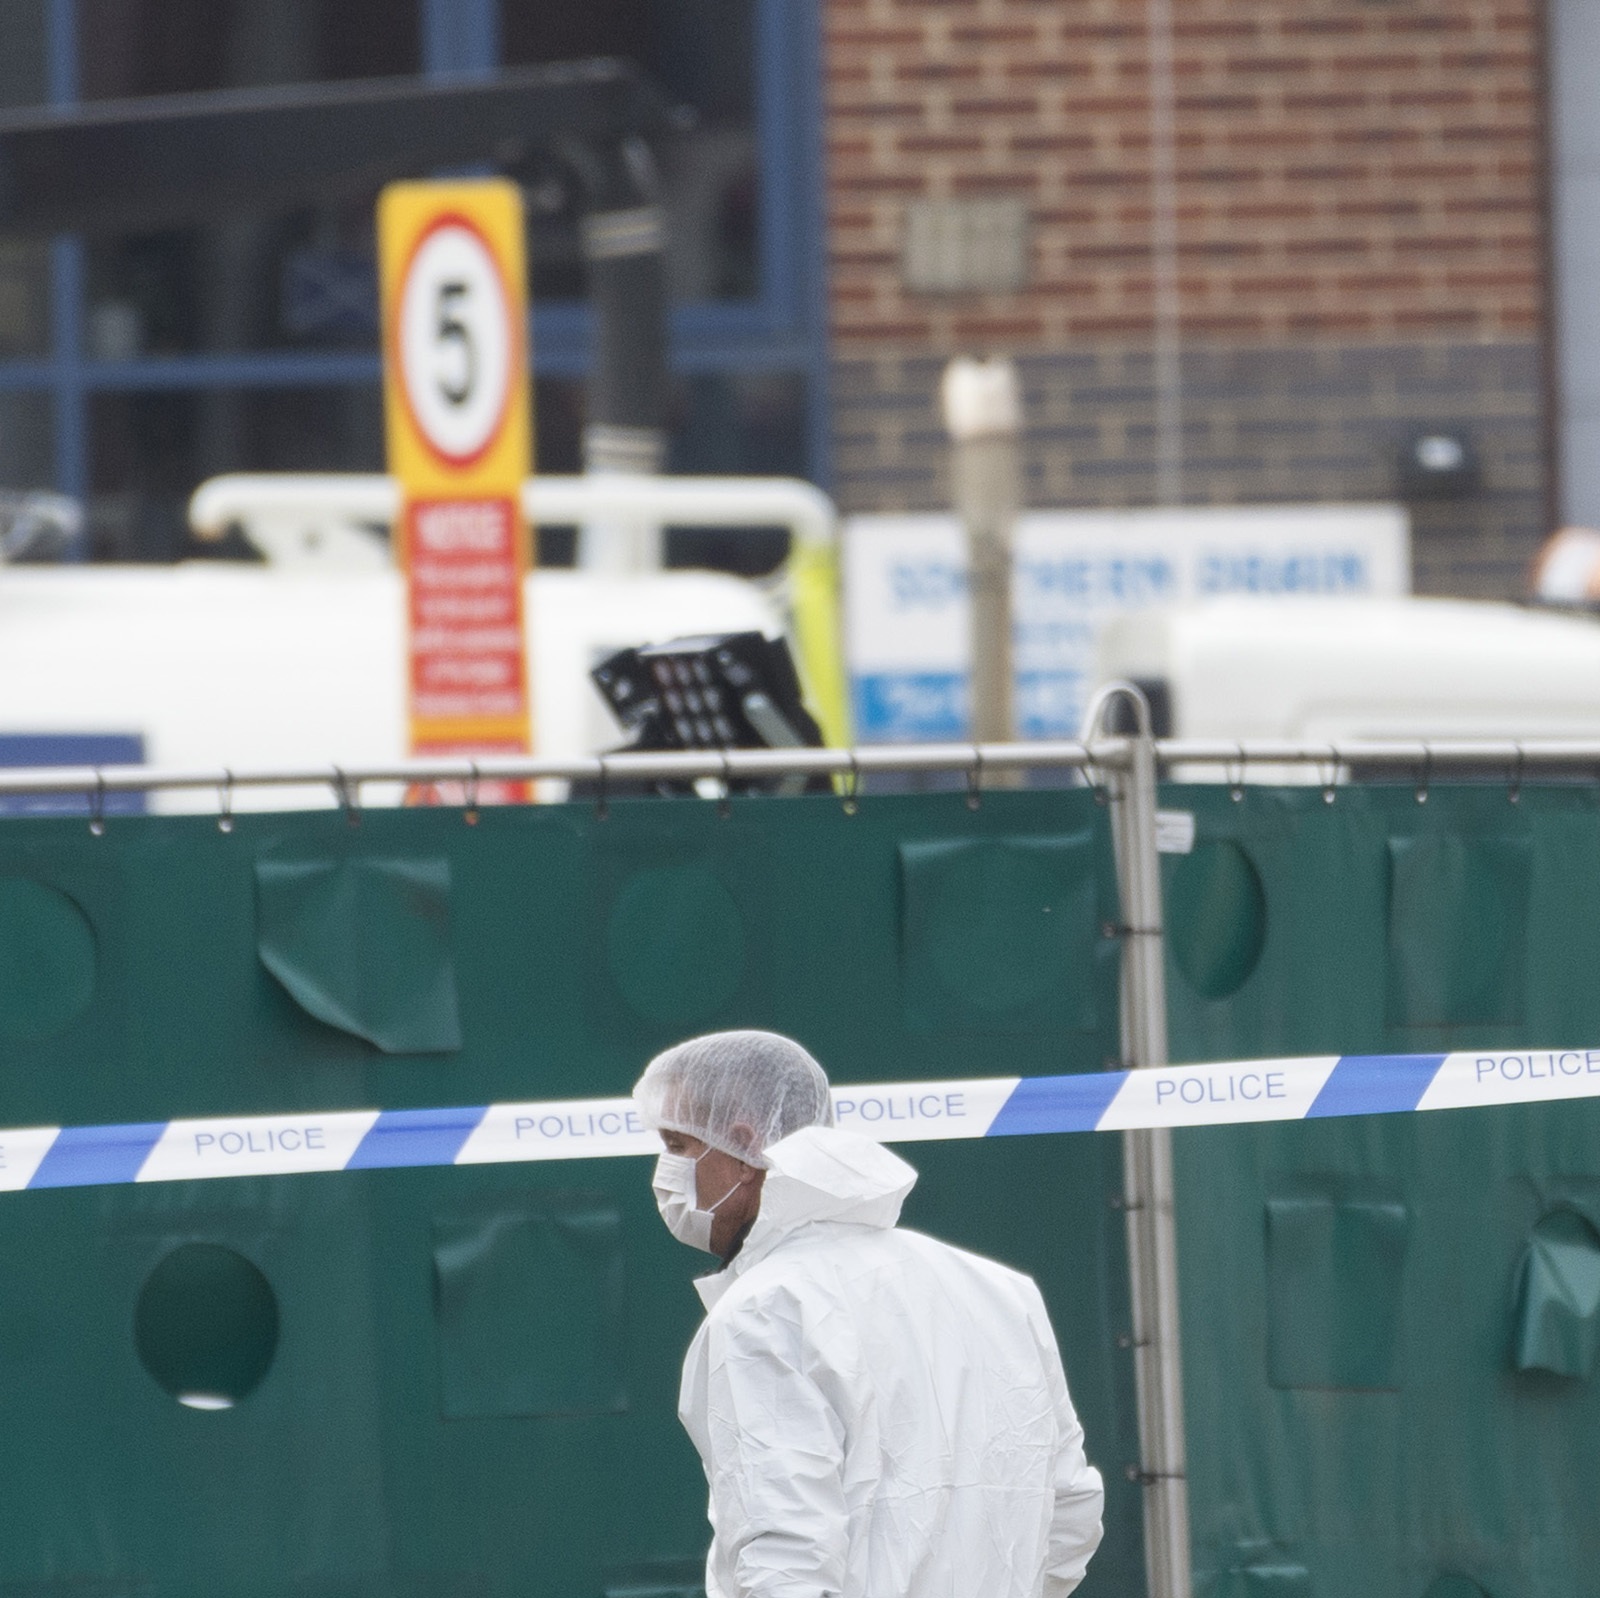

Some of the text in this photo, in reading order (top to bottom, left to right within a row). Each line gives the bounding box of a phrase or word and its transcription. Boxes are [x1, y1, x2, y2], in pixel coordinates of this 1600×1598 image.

[437, 280, 479, 405] 5
[1154, 1072, 1287, 1105] POLICE
[835, 1093, 967, 1122] POLICE
[514, 1111, 647, 1140] POLICE
[194, 1127, 326, 1157] POLICE
